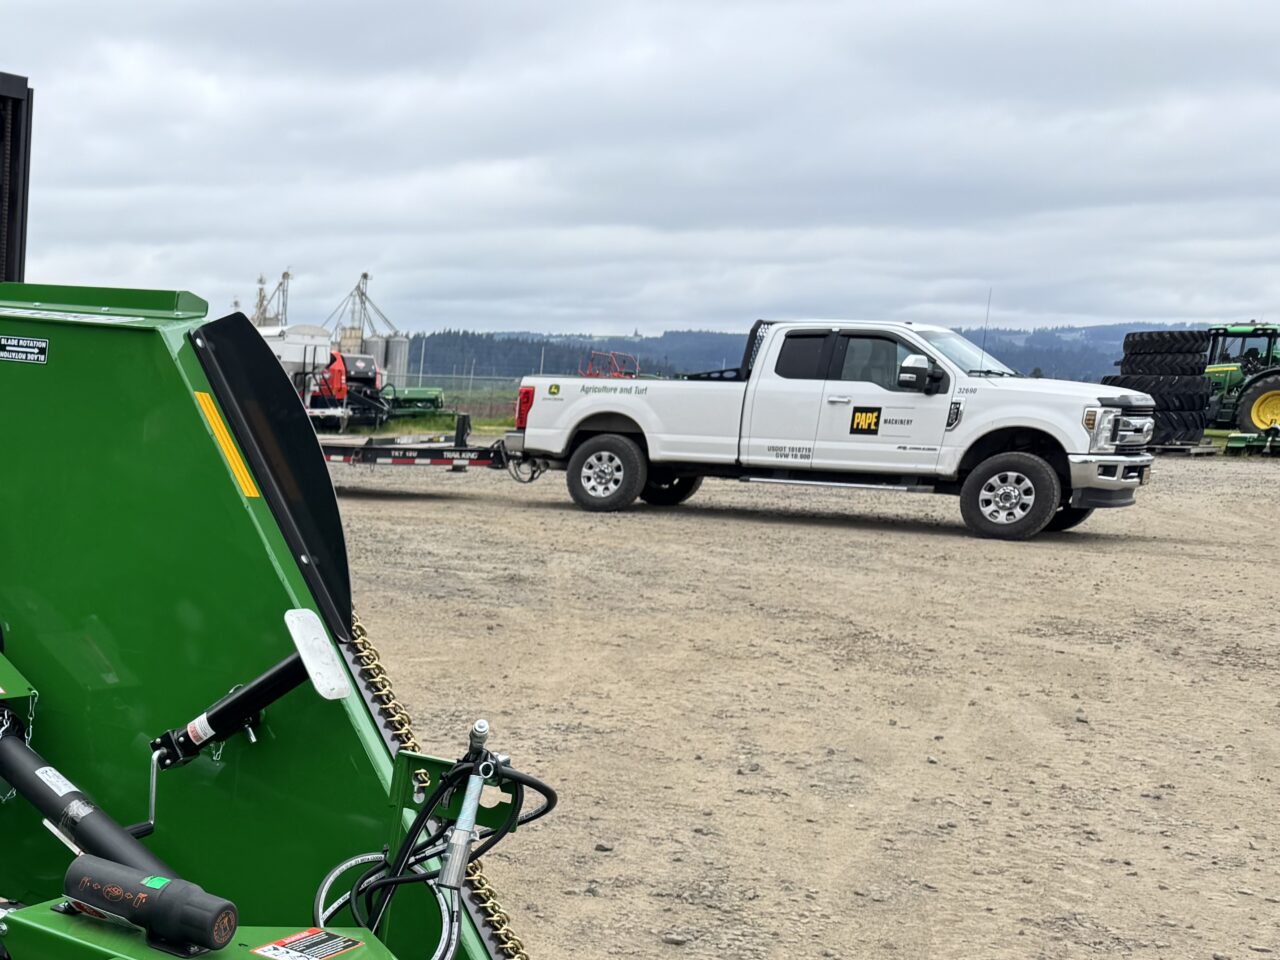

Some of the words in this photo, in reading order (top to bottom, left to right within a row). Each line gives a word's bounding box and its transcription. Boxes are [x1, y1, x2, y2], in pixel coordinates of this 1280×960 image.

[19, 340, 47, 348] ROTATION
[580, 385, 618, 395] Agriculture
[619, 386, 632, 394] and
[634, 386, 648, 395] Turf
[883, 418, 913, 426] MACHINERY
[443, 451, 460, 459] TRAIL
